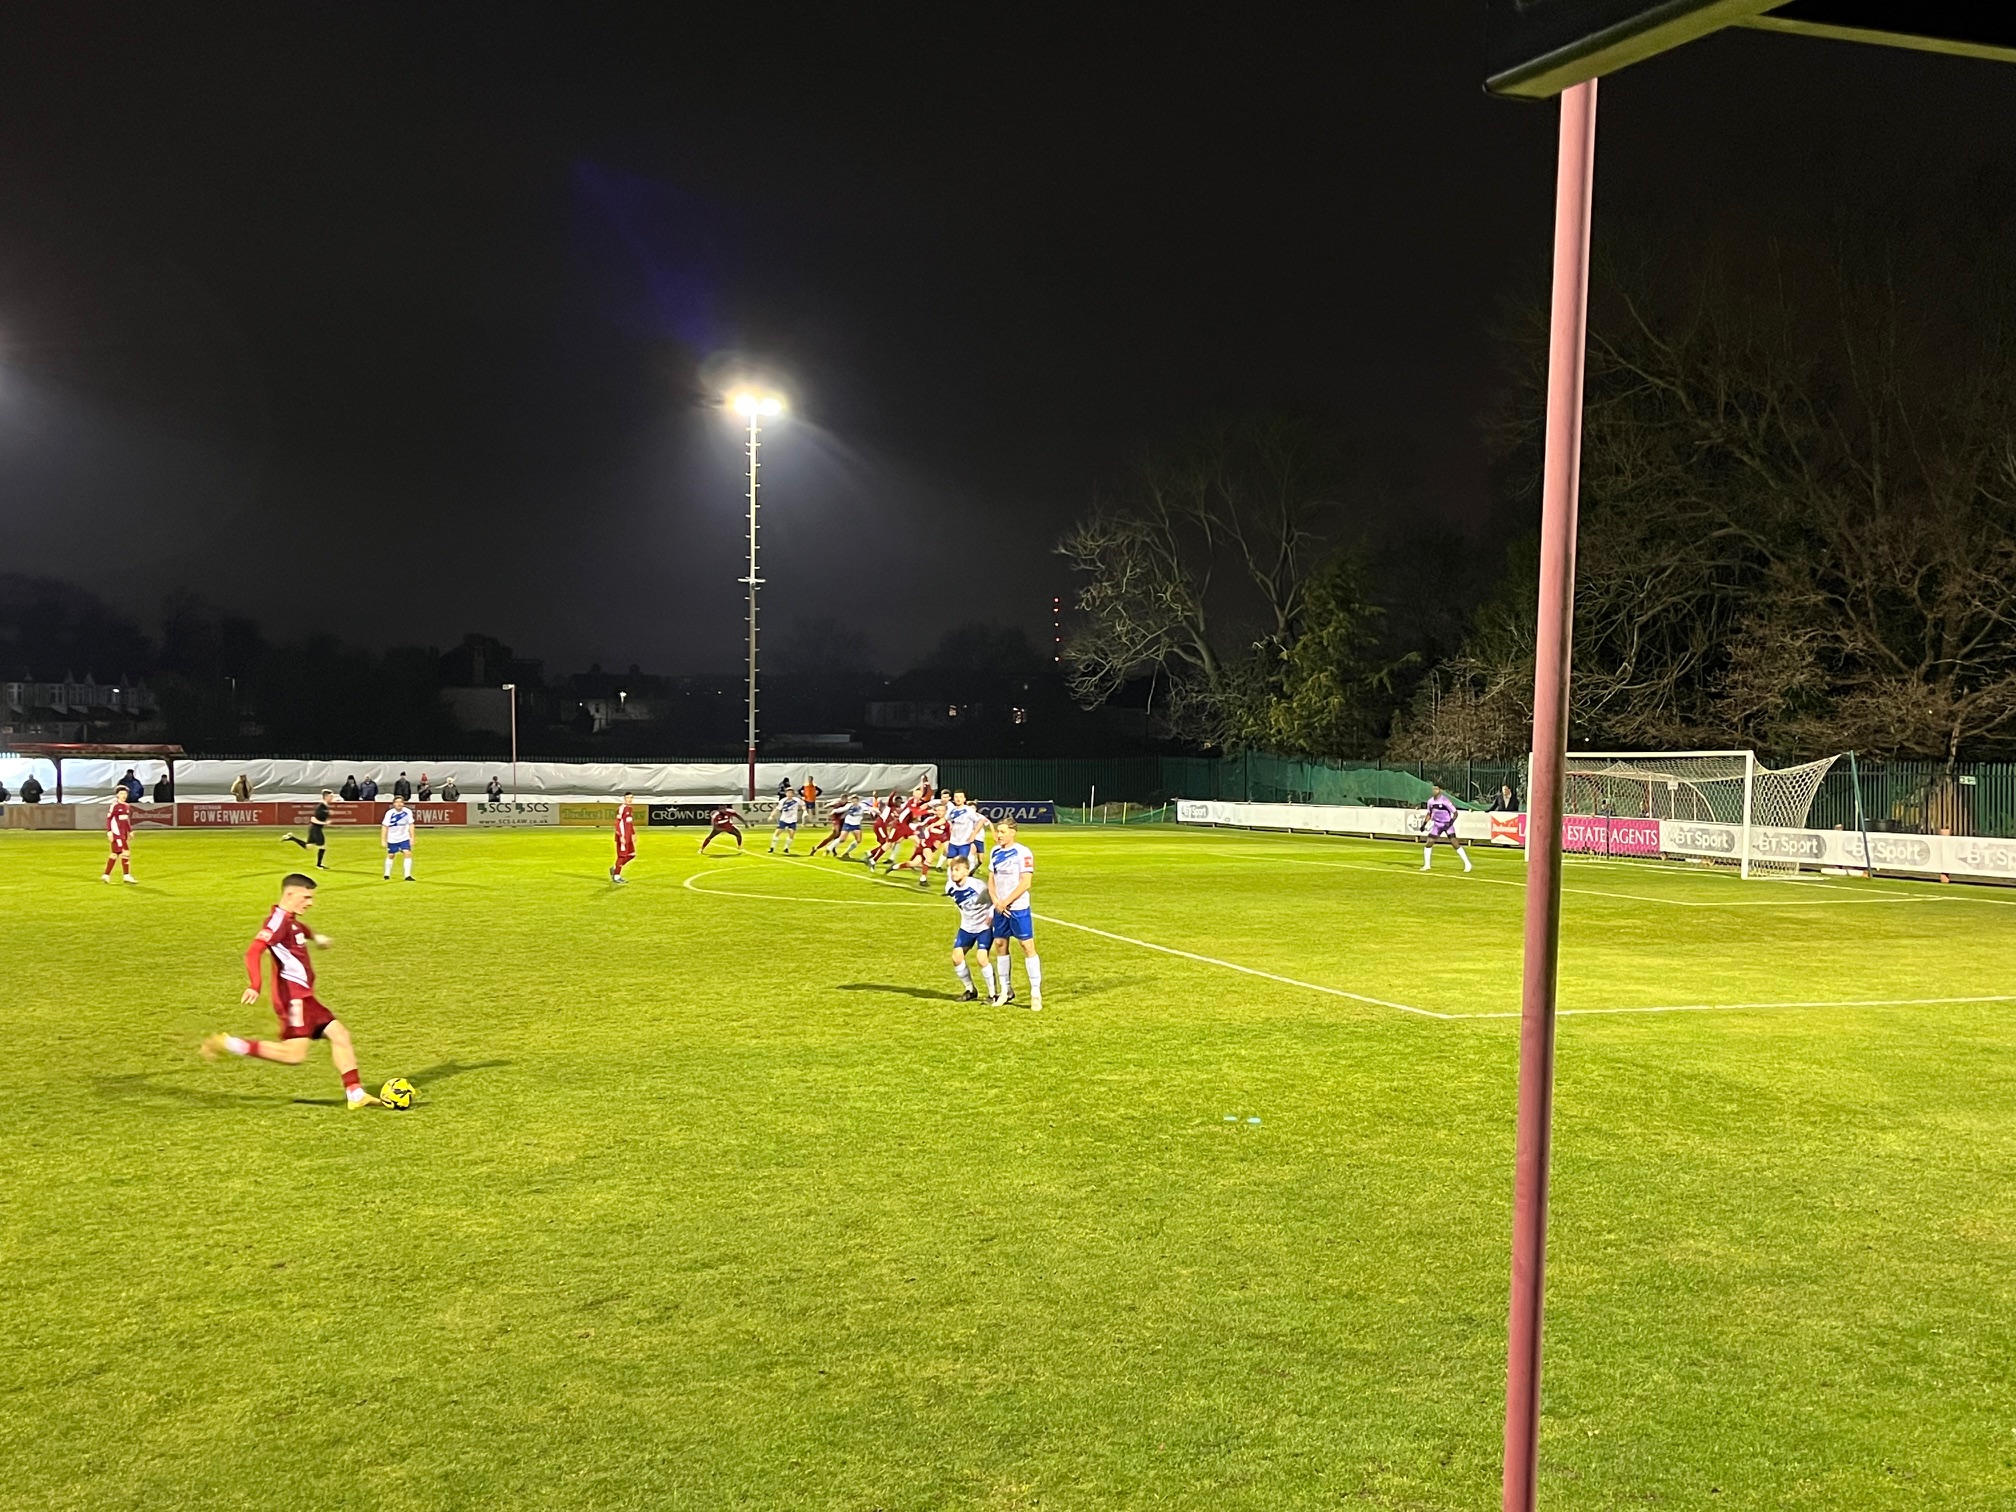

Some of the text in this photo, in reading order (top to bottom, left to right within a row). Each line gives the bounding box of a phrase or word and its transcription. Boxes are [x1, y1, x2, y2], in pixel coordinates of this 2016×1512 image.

[489, 803, 512, 813] SCS
[526, 803, 550, 813] SCS
[651, 809, 695, 820] CROWN
[978, 806, 1037, 819] CORAL
[193, 809, 259, 824] POWERWAVE
[1567, 825, 1658, 846] ESTATE AGENTS
[1674, 830, 1728, 850] BT Sport
[1758, 835, 1818, 857] BT Sport
[1877, 839, 1922, 862] Sport
[1966, 848, 1995, 865] BT
